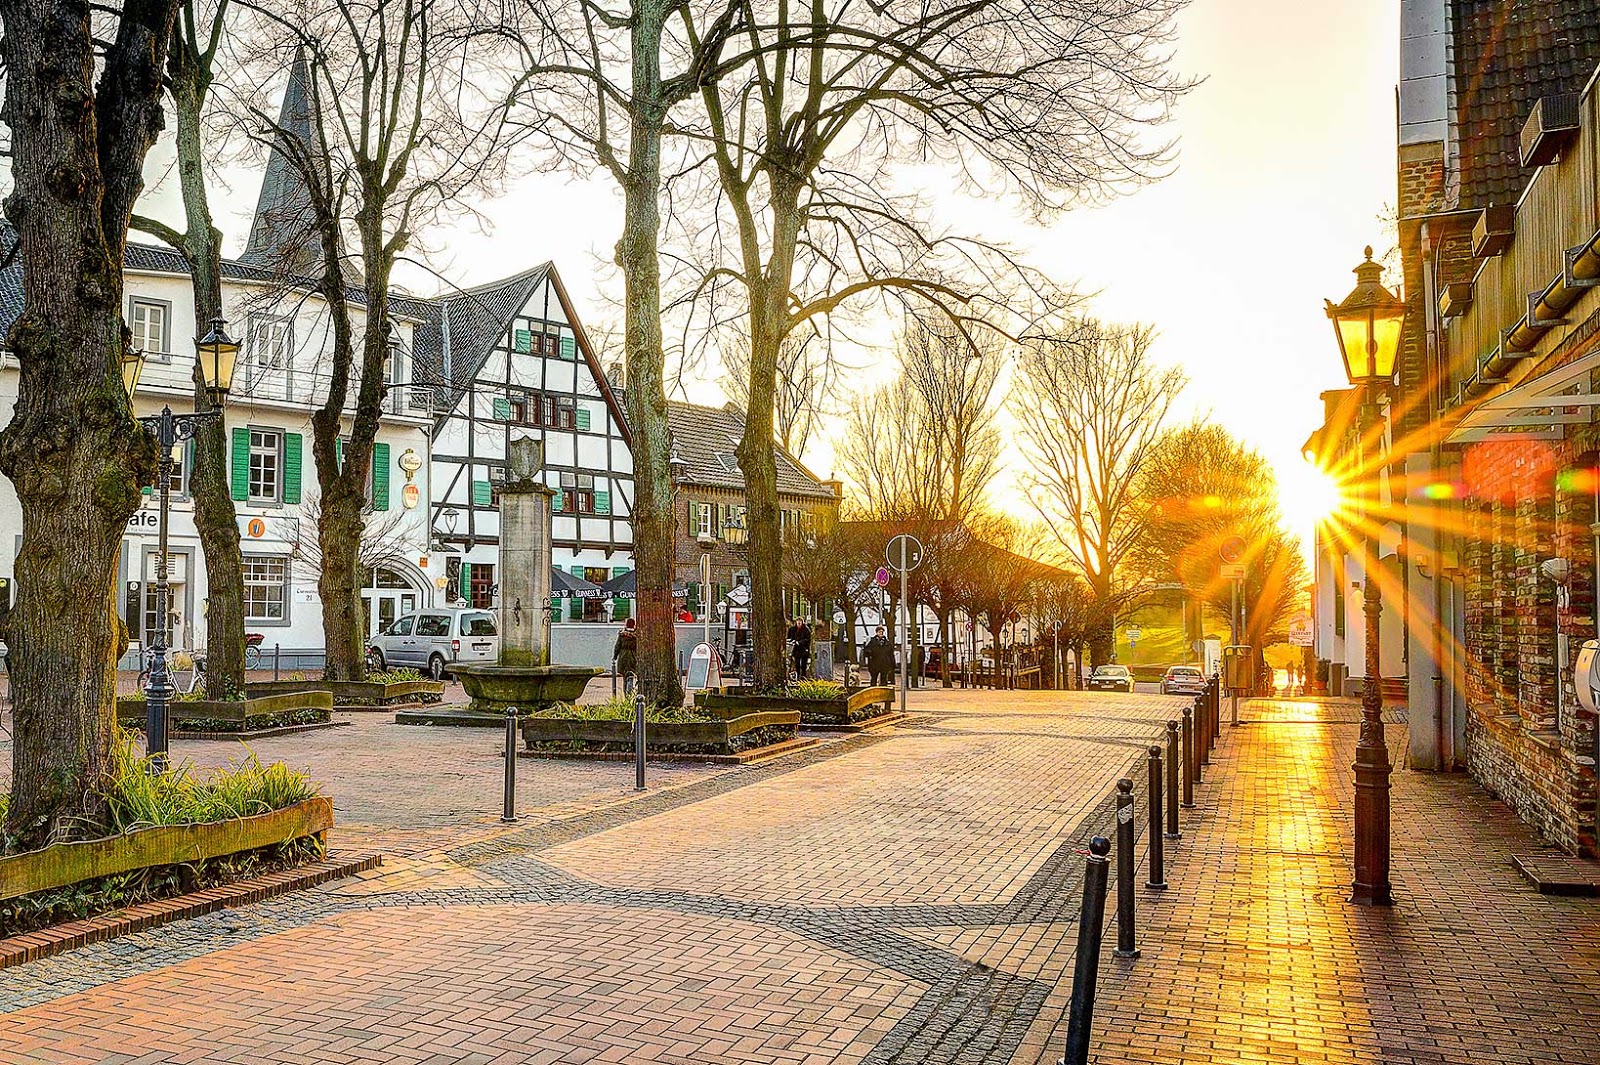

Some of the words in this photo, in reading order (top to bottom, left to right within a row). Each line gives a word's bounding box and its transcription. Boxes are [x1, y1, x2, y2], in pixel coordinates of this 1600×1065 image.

[129, 511, 158, 527] afe
[619, 590, 637, 599] GUIN
[671, 590, 685, 598] NESS
